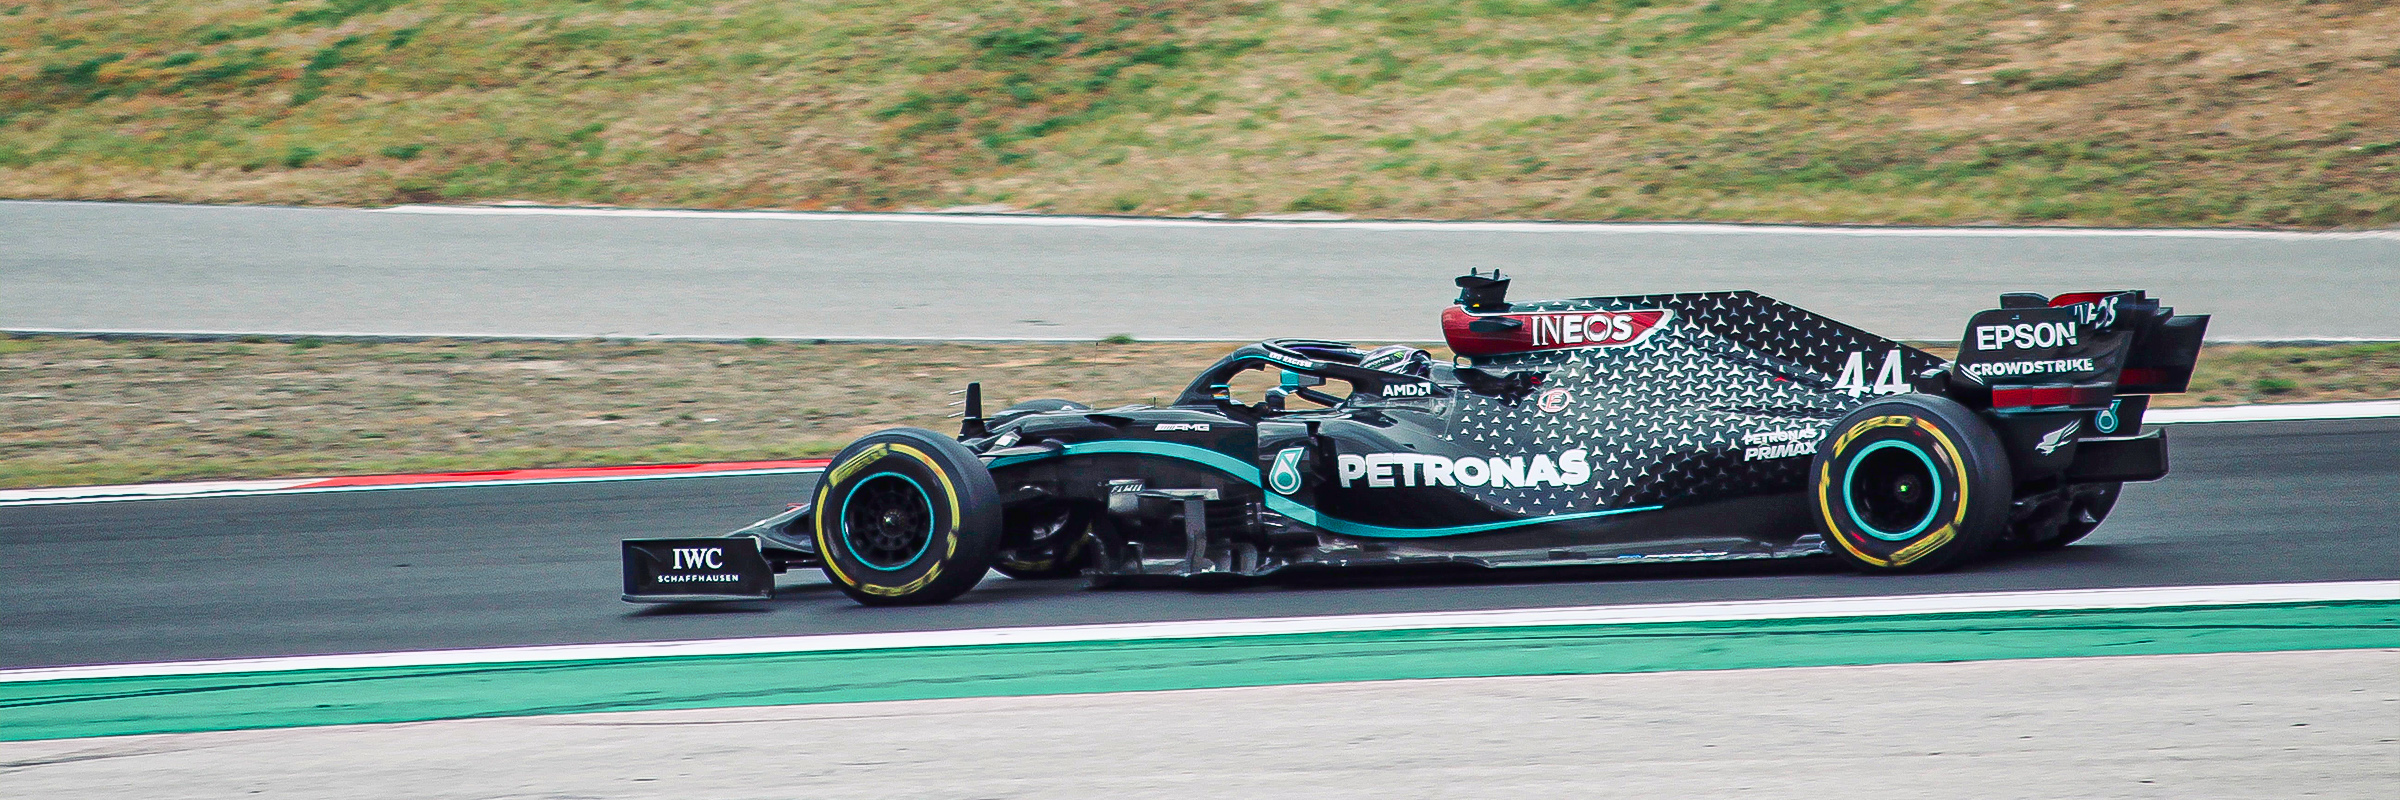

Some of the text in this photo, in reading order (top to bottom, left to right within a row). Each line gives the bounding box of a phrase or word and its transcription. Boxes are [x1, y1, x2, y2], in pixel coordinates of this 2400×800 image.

[1532, 314, 1633, 346] INEOS
[1977, 321, 2077, 350] EPSON
[1832, 349, 1911, 398] 44
[1971, 358, 2094, 377] CROWDSTRIKE
[1383, 383, 1417, 397] AMD
[1744, 428, 1818, 445] PETRONAS
[1744, 440, 1817, 461] PRIMAX
[1338, 449, 1590, 488] PETRONAS
[672, 548, 722, 569] IWC
[657, 574, 739, 583] SCHAFFHAUSEN
